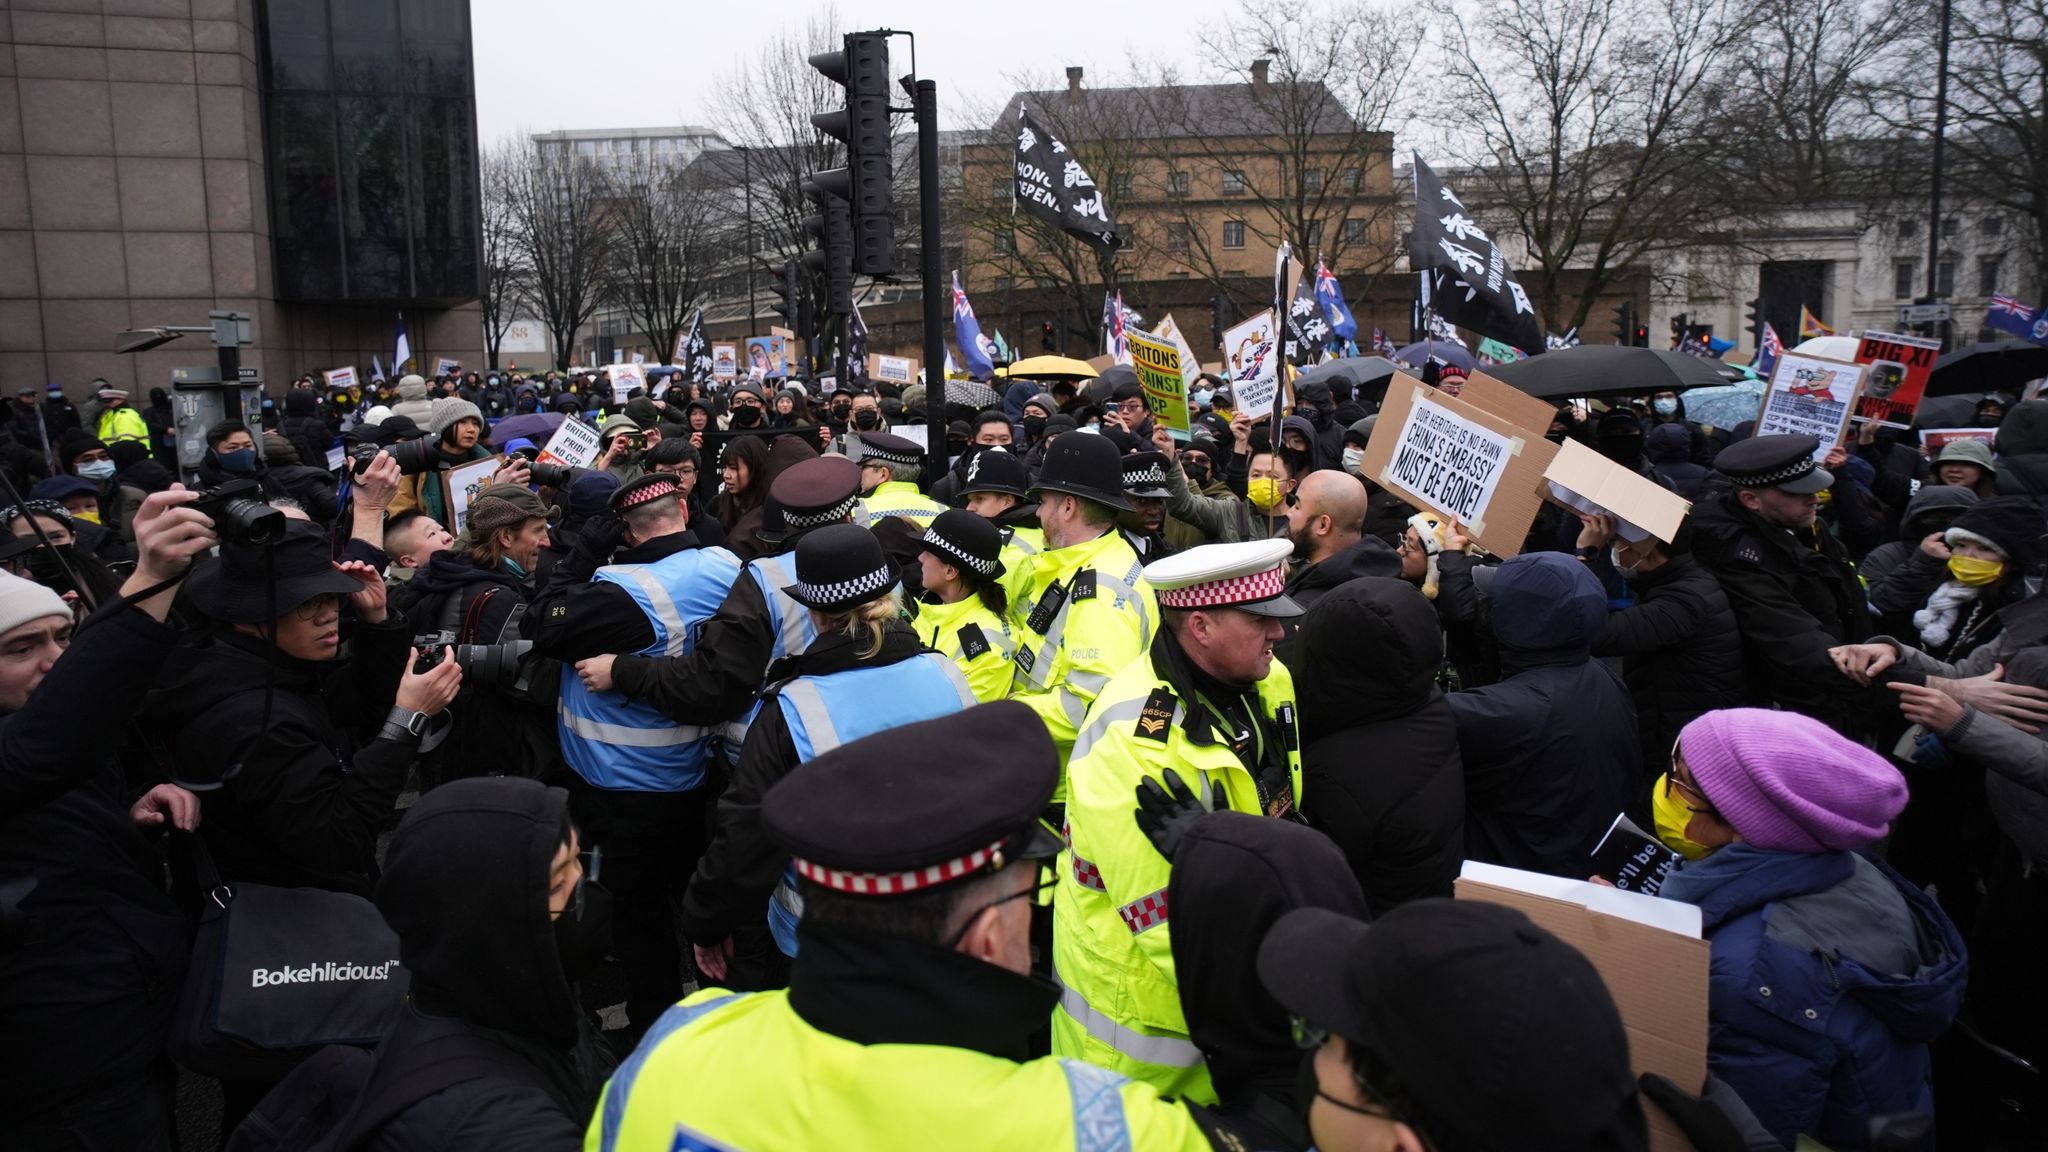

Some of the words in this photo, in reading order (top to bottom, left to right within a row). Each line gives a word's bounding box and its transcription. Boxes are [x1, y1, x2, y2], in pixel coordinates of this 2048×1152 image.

[511, 327, 528, 339] 88
[1129, 339, 1179, 370] BRITONS
[1863, 339, 1904, 361] BIG
[1908, 346, 1932, 368] XI
[1135, 363, 1181, 394] AGAINST
[563, 437, 588, 455] PRIDE
[565, 422, 600, 449] BRITAIN'S
[1415, 407, 1430, 423] OUR
[1430, 414, 1459, 440] HERITAGE
[1457, 429, 1468, 445] IS
[1469, 434, 1480, 450] NO
[1480, 438, 1502, 461] PAWN
[553, 446, 565, 457] NO
[565, 454, 581, 466] CCP
[1406, 423, 1446, 459] CHINA'S
[1443, 442, 1496, 484] EMBASSY
[1392, 444, 1431, 486] MUST
[1423, 462, 1446, 499] BE
[1440, 472, 1484, 520] GONE!
[1071, 648, 1100, 660] POLICE
[1142, 708, 1172, 718] 665CP
[1616, 862, 1641, 890] e'll
[1633, 843, 1657, 865] be
